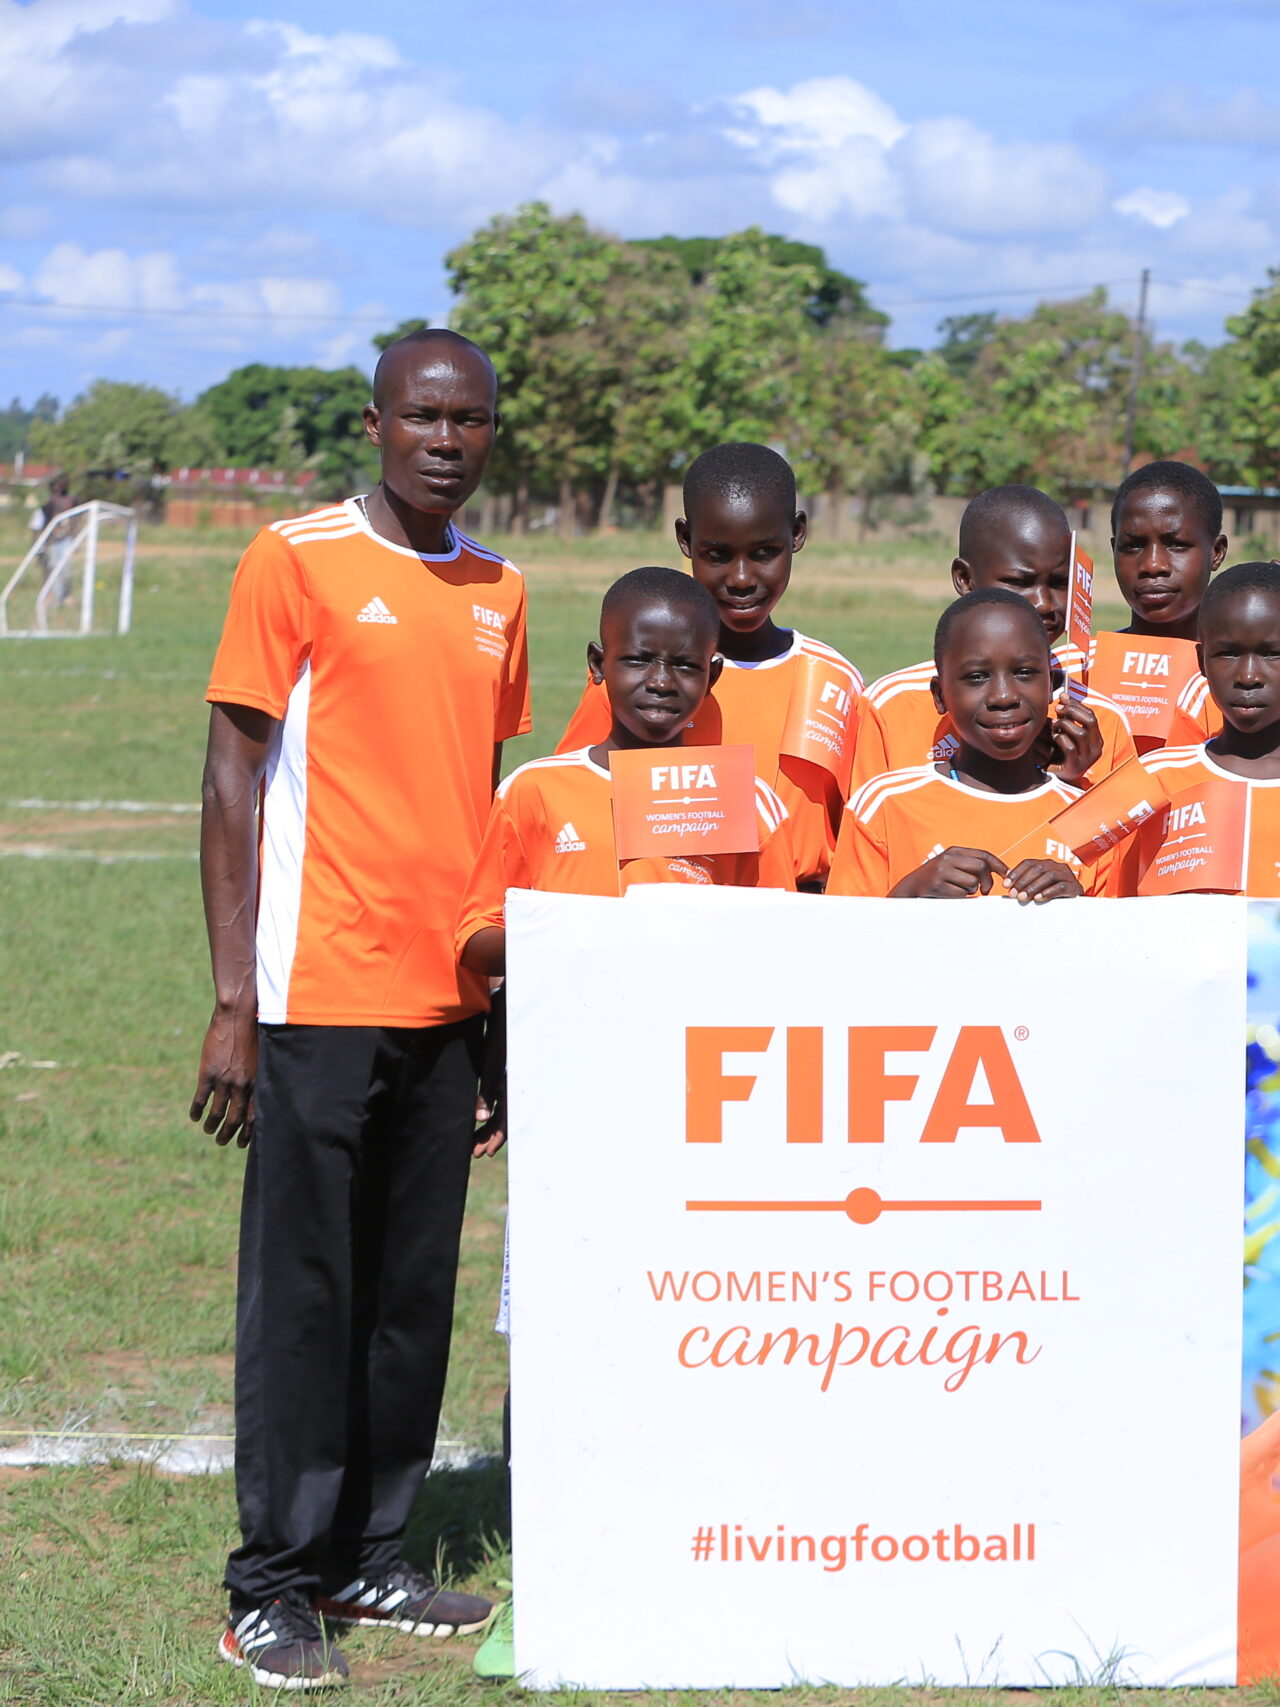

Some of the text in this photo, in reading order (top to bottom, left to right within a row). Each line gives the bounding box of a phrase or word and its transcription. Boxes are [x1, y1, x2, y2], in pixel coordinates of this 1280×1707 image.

[356, 613, 398, 625] adidas
[1122, 651, 1169, 677] FIFA
[926, 747, 954, 760] adid
[651, 764, 718, 791] FIFA
[646, 810, 726, 821] WOMEN'S FOOTBALL
[652, 819, 719, 837] campaign
[555, 841, 586, 854] adidas
[646, 1269, 1081, 1302] WOMEN'S FOOTBALL
[677, 1306, 1043, 1393] campaign
[691, 1523, 1036, 1572] #livingfootball
